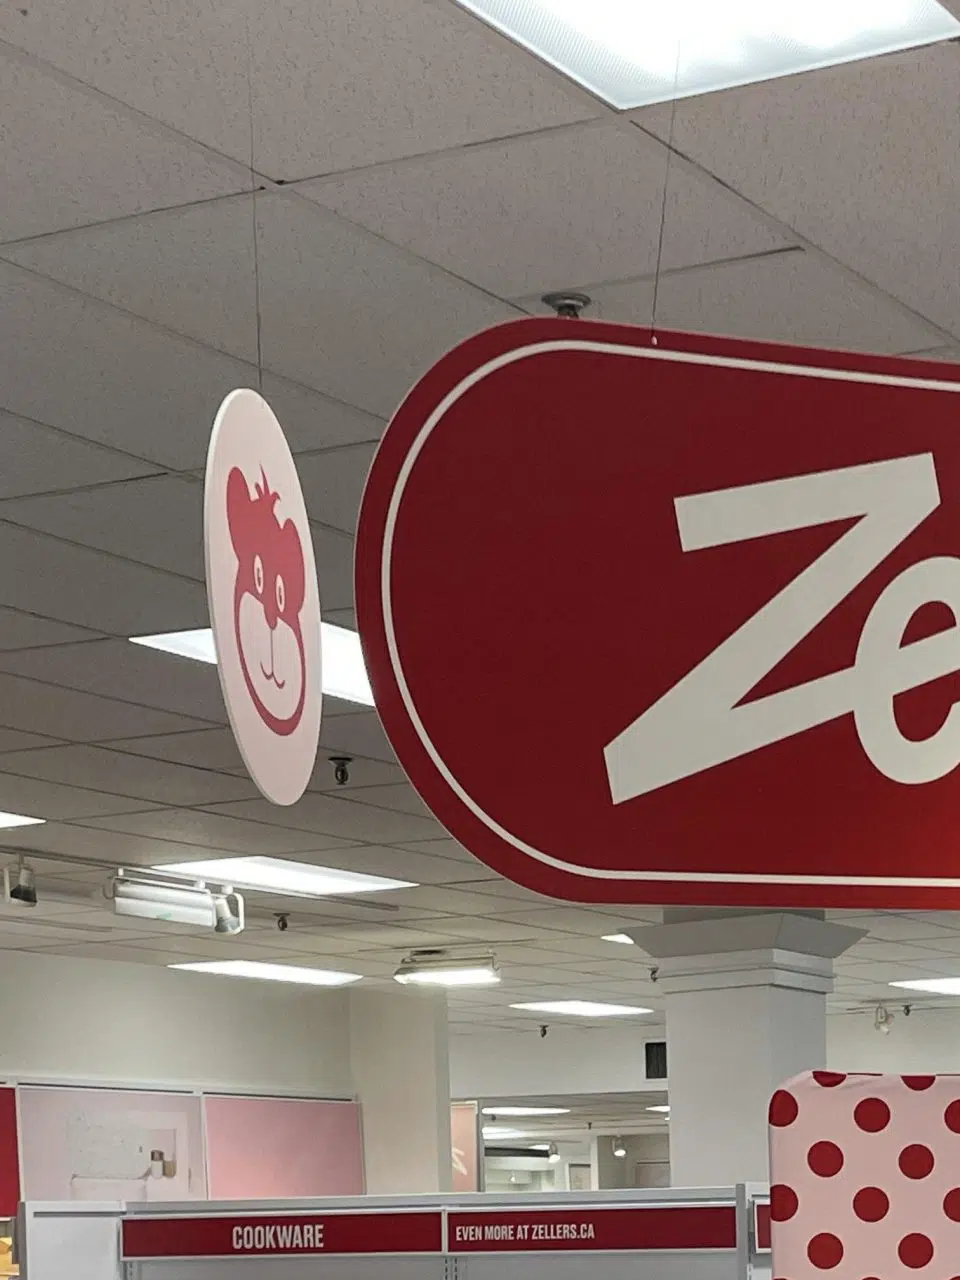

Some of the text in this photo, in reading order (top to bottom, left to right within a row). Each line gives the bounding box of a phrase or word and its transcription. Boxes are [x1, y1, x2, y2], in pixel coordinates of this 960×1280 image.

[232, 1224, 324, 1249] COOKWARE
[456, 1223, 595, 1241] EVEN MORE AT ZELLERS.CA
